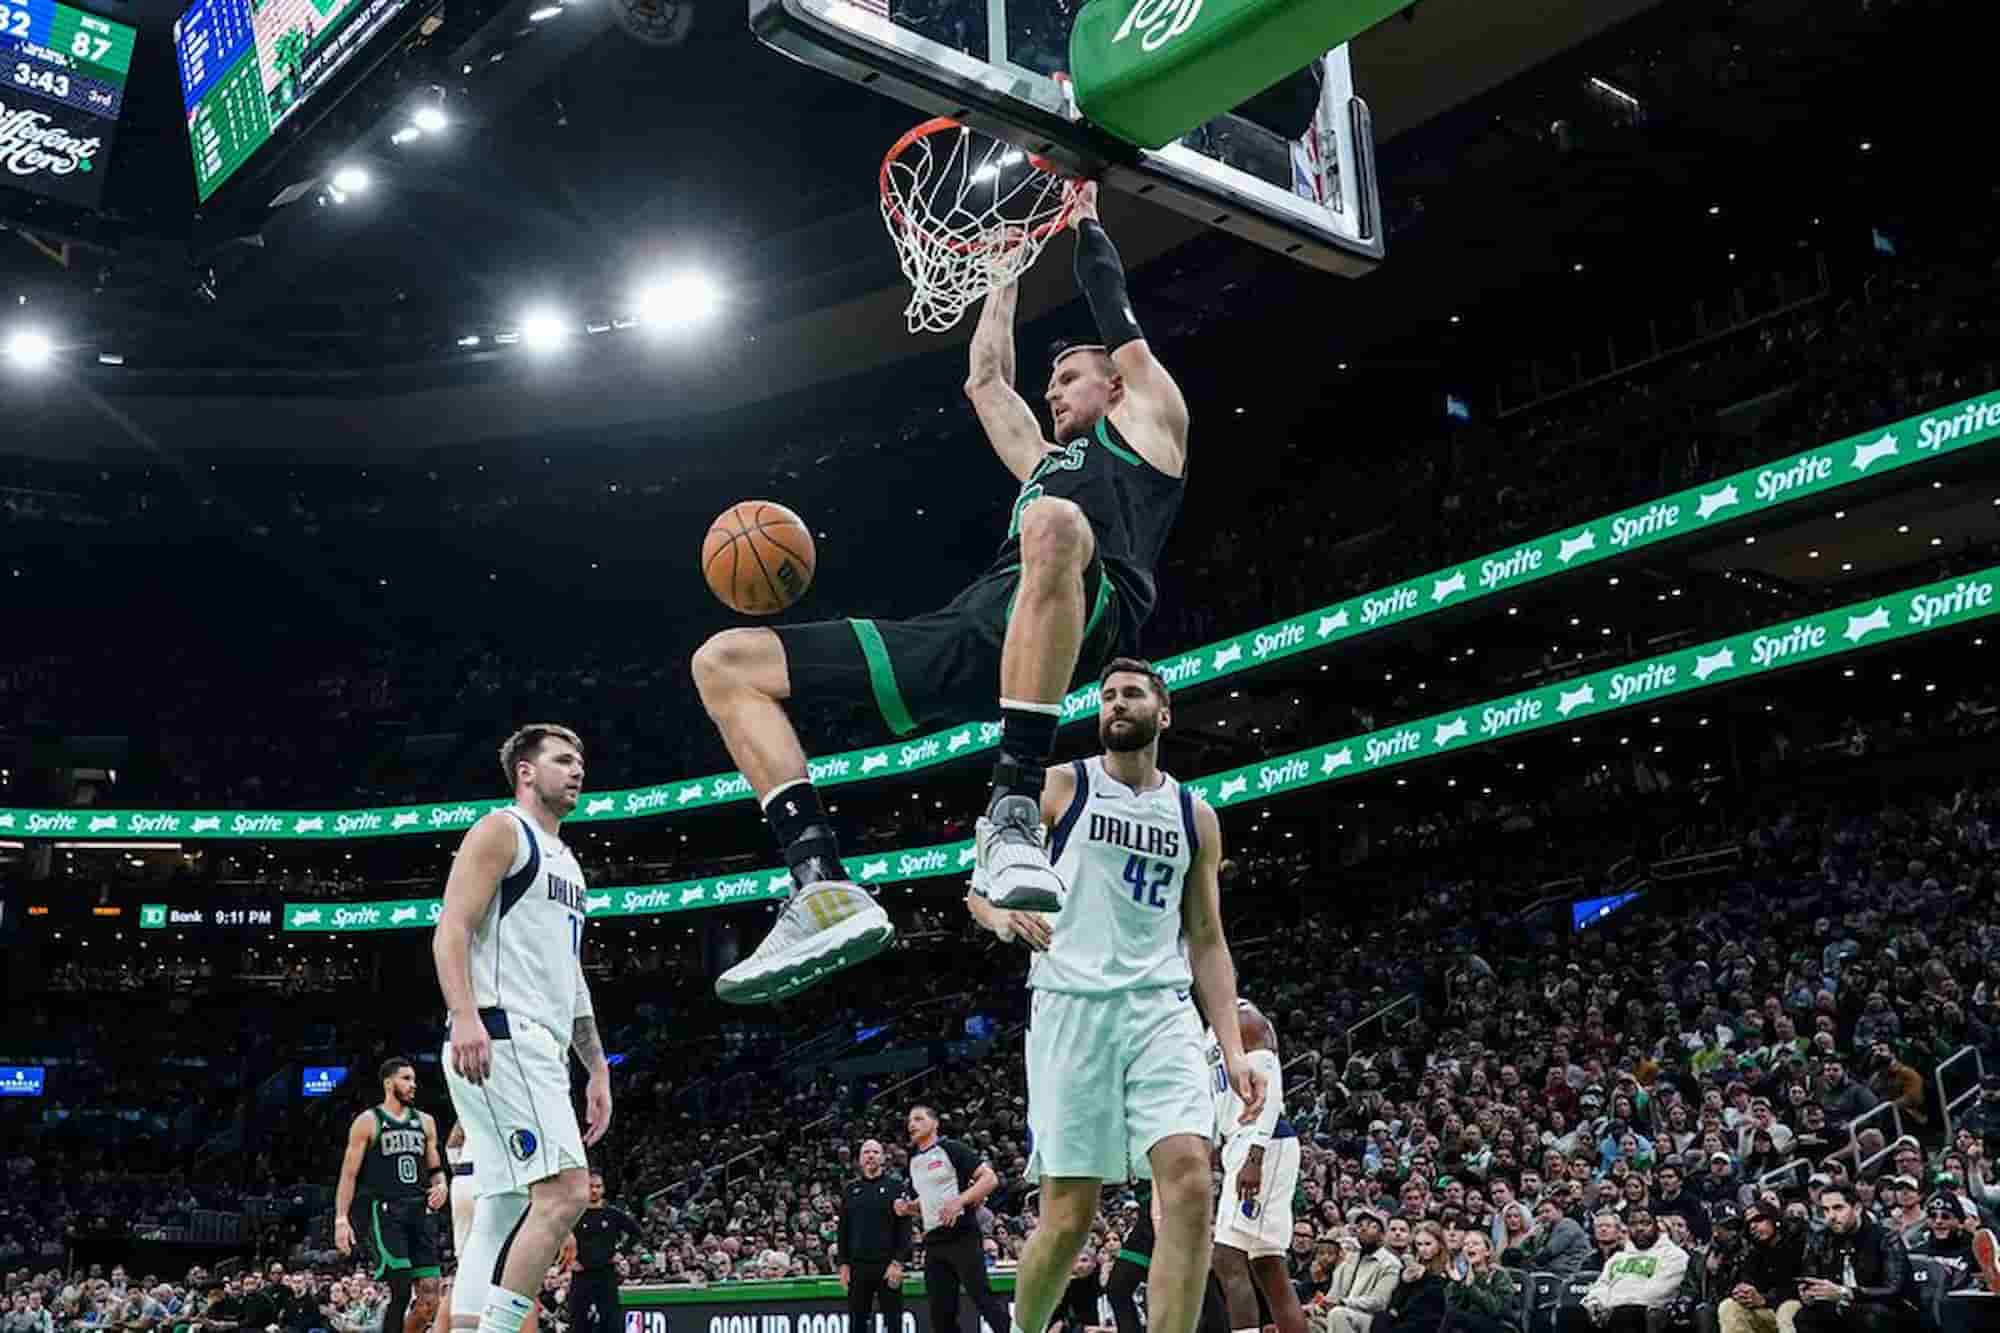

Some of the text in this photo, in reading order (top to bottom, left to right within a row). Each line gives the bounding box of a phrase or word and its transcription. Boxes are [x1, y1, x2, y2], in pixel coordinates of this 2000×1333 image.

[71, 31, 112, 61] 87
[14, 62, 69, 97] 3:43
[25, 812, 78, 833] Sprite
[128, 813, 179, 833] Sprite
[231, 814, 282, 834] Sprite
[333, 813, 381, 834] Sprite
[428, 805, 476, 827] Sprite
[623, 790, 668, 813] Sprite
[898, 739, 939, 767] Sprite
[1062, 686, 1103, 718] Sprit
[1252, 624, 1305, 658] Sprite
[1360, 588, 1418, 625] Sprite
[1479, 549, 1542, 588] Sprite
[1610, 505, 1679, 546] Sprite
[1755, 456, 1832, 500] Sprite
[1917, 401, 2000, 450] Sprite
[331, 581, 1992, 929] Sprite Sprite Sprite Sprite Sprite Sprite Sprite Sprite Sprite Sprite
[1089, 813, 1180, 858] DALLAS
[1123, 852, 1175, 909] 42
[170, 909, 202, 923] Bank
[215, 909, 272, 925] 9:11 PM
[398, 1155, 418, 1183] 0
